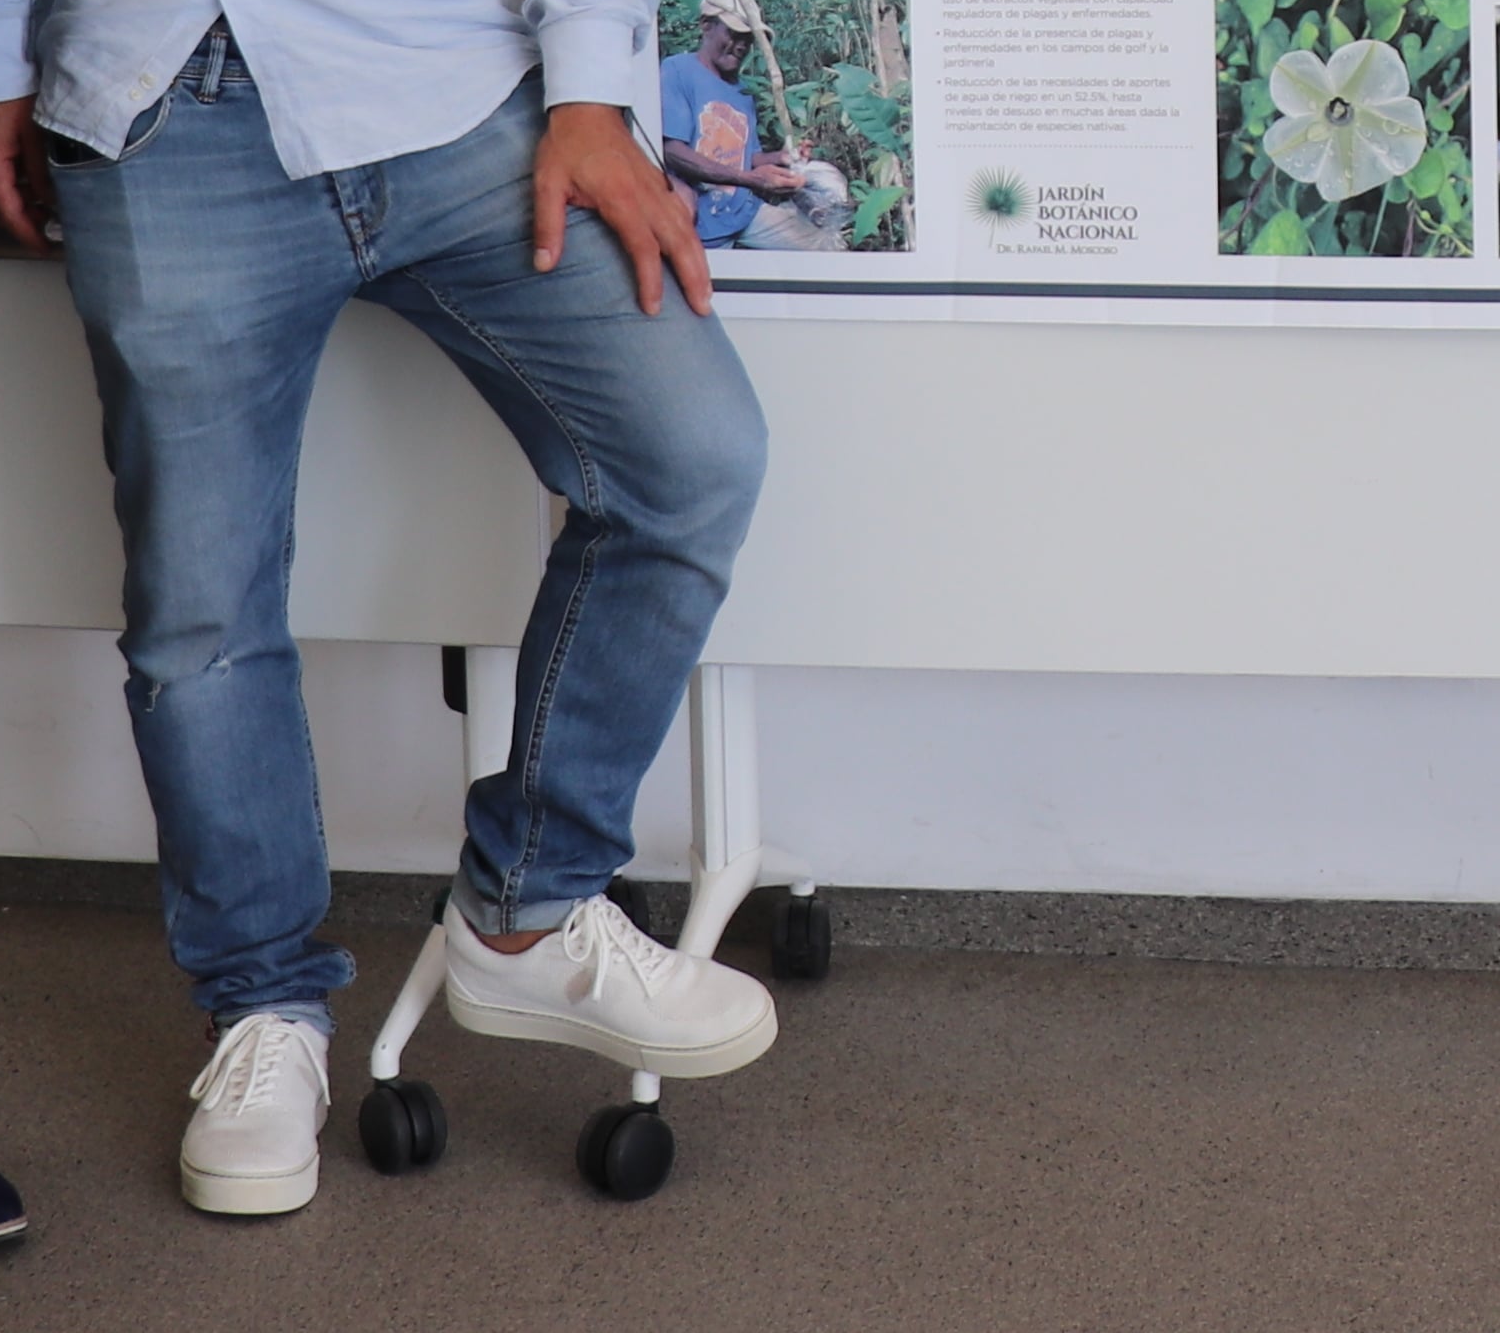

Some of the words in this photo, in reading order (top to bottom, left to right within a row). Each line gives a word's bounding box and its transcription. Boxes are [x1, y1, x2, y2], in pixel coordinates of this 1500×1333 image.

[1037, 184, 1104, 204] JARDÍN
[1037, 203, 1138, 221] BOTÁNICO
[1035, 222, 1138, 242] NACIONAL
